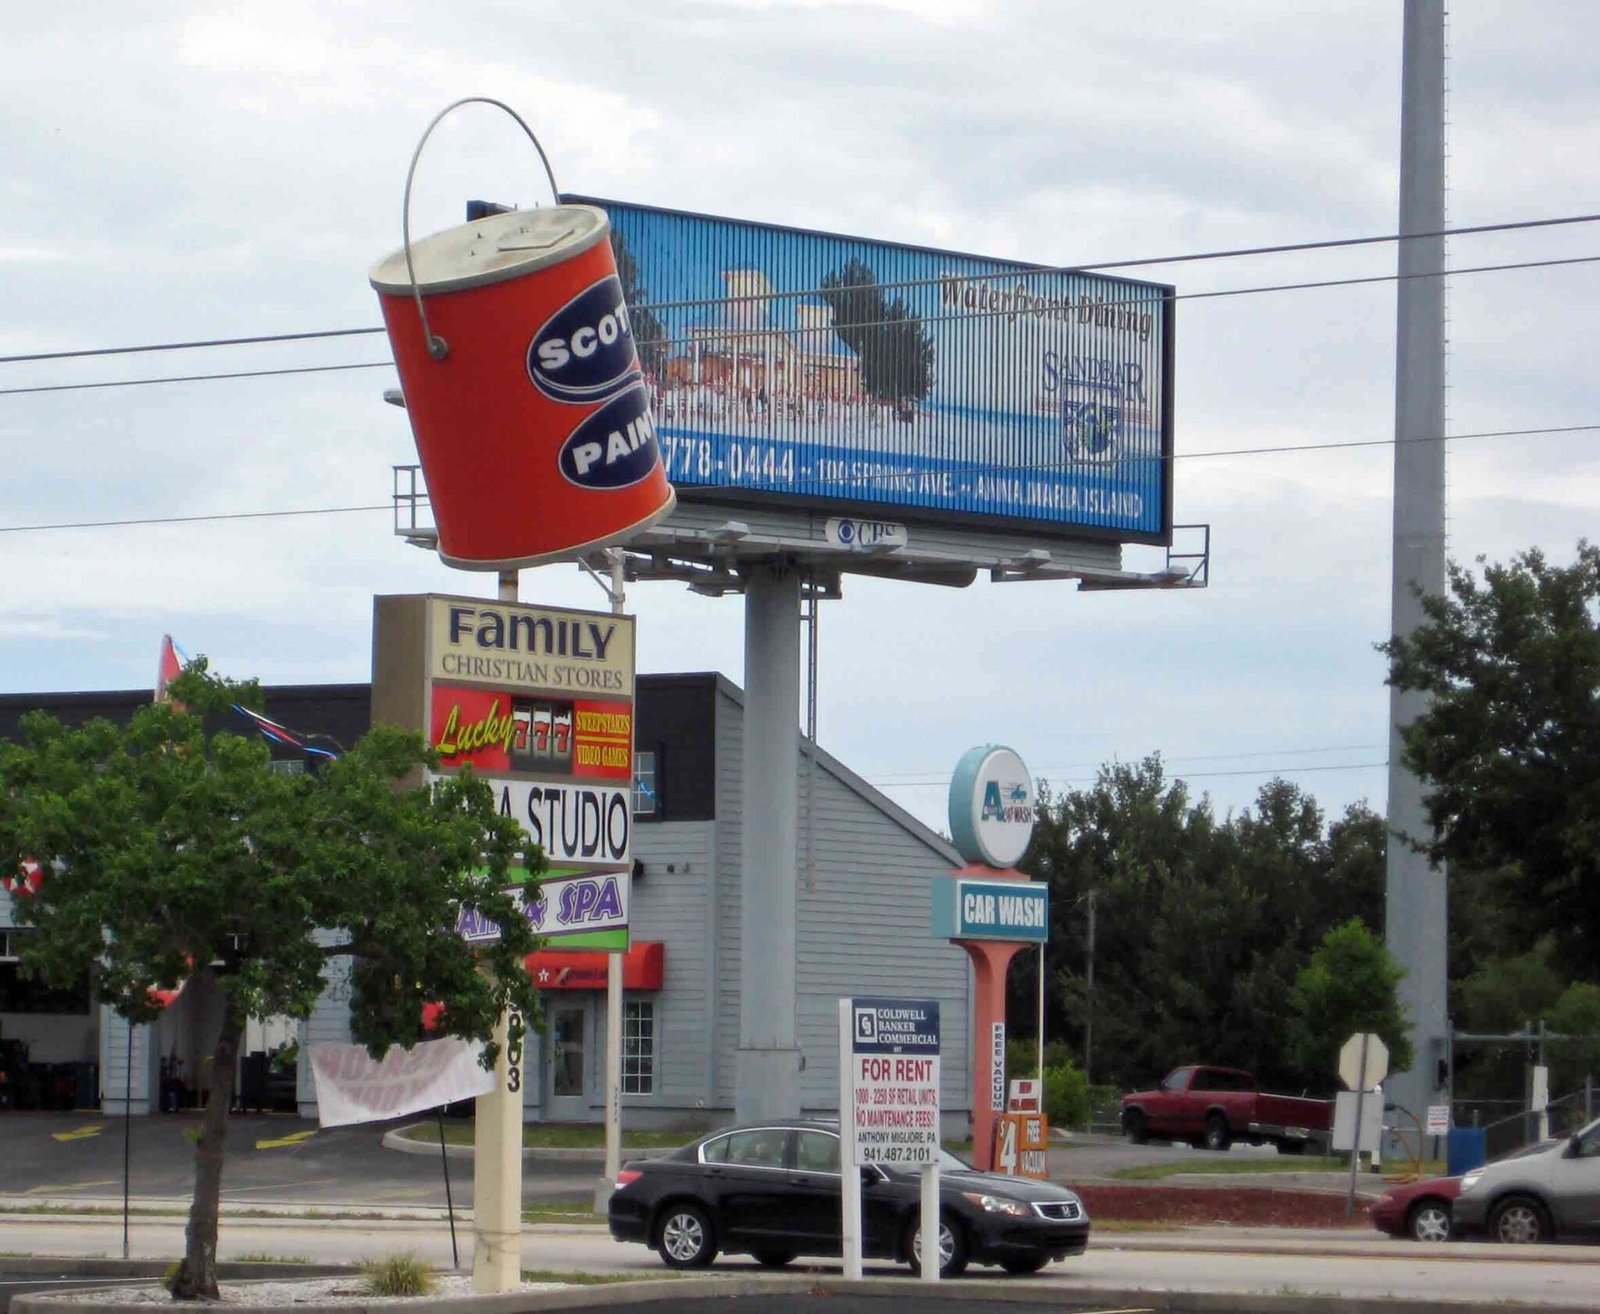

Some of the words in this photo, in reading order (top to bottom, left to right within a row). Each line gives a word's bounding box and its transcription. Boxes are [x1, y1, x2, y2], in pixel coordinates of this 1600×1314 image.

[941, 274, 1070, 322] Waterfront
[1077, 295, 1152, 342] Dining
[662, 436, 794, 485] 778-0444
[1083, 488, 1143, 518] ISLAND
[442, 653, 548, 684] CHRISTIAN
[554, 666, 623, 690] STORES
[435, 699, 514, 754] Lucky
[575, 710, 630, 735] SWEEPSTAKES
[577, 744, 600, 766] VIDEO
[602, 746, 629, 768] GAMES
[527, 786, 629, 861] STUDIO
[557, 877, 623, 926] SPA
[964, 893, 995, 925] CAR
[999, 896, 1045, 928] WASH
[878, 1009, 926, 1020] COLDWELL
[879, 1021, 915, 1032] BANKER
[879, 1033, 938, 1045] COMMERCIAL
[862, 1058, 891, 1081] FOR
[896, 1059, 933, 1082] RENT
[897, 1088, 917, 1105] RETAIL
[993, 1061, 1003, 1109] VACUUM
[856, 1109, 866, 1127] NO
[868, 1110, 913, 1127] MAINTENANCE
[858, 1132, 890, 1143] ANTHONY
[927, 1132, 936, 1143] PA
[864, 1147, 930, 1162] 941.487.2101
